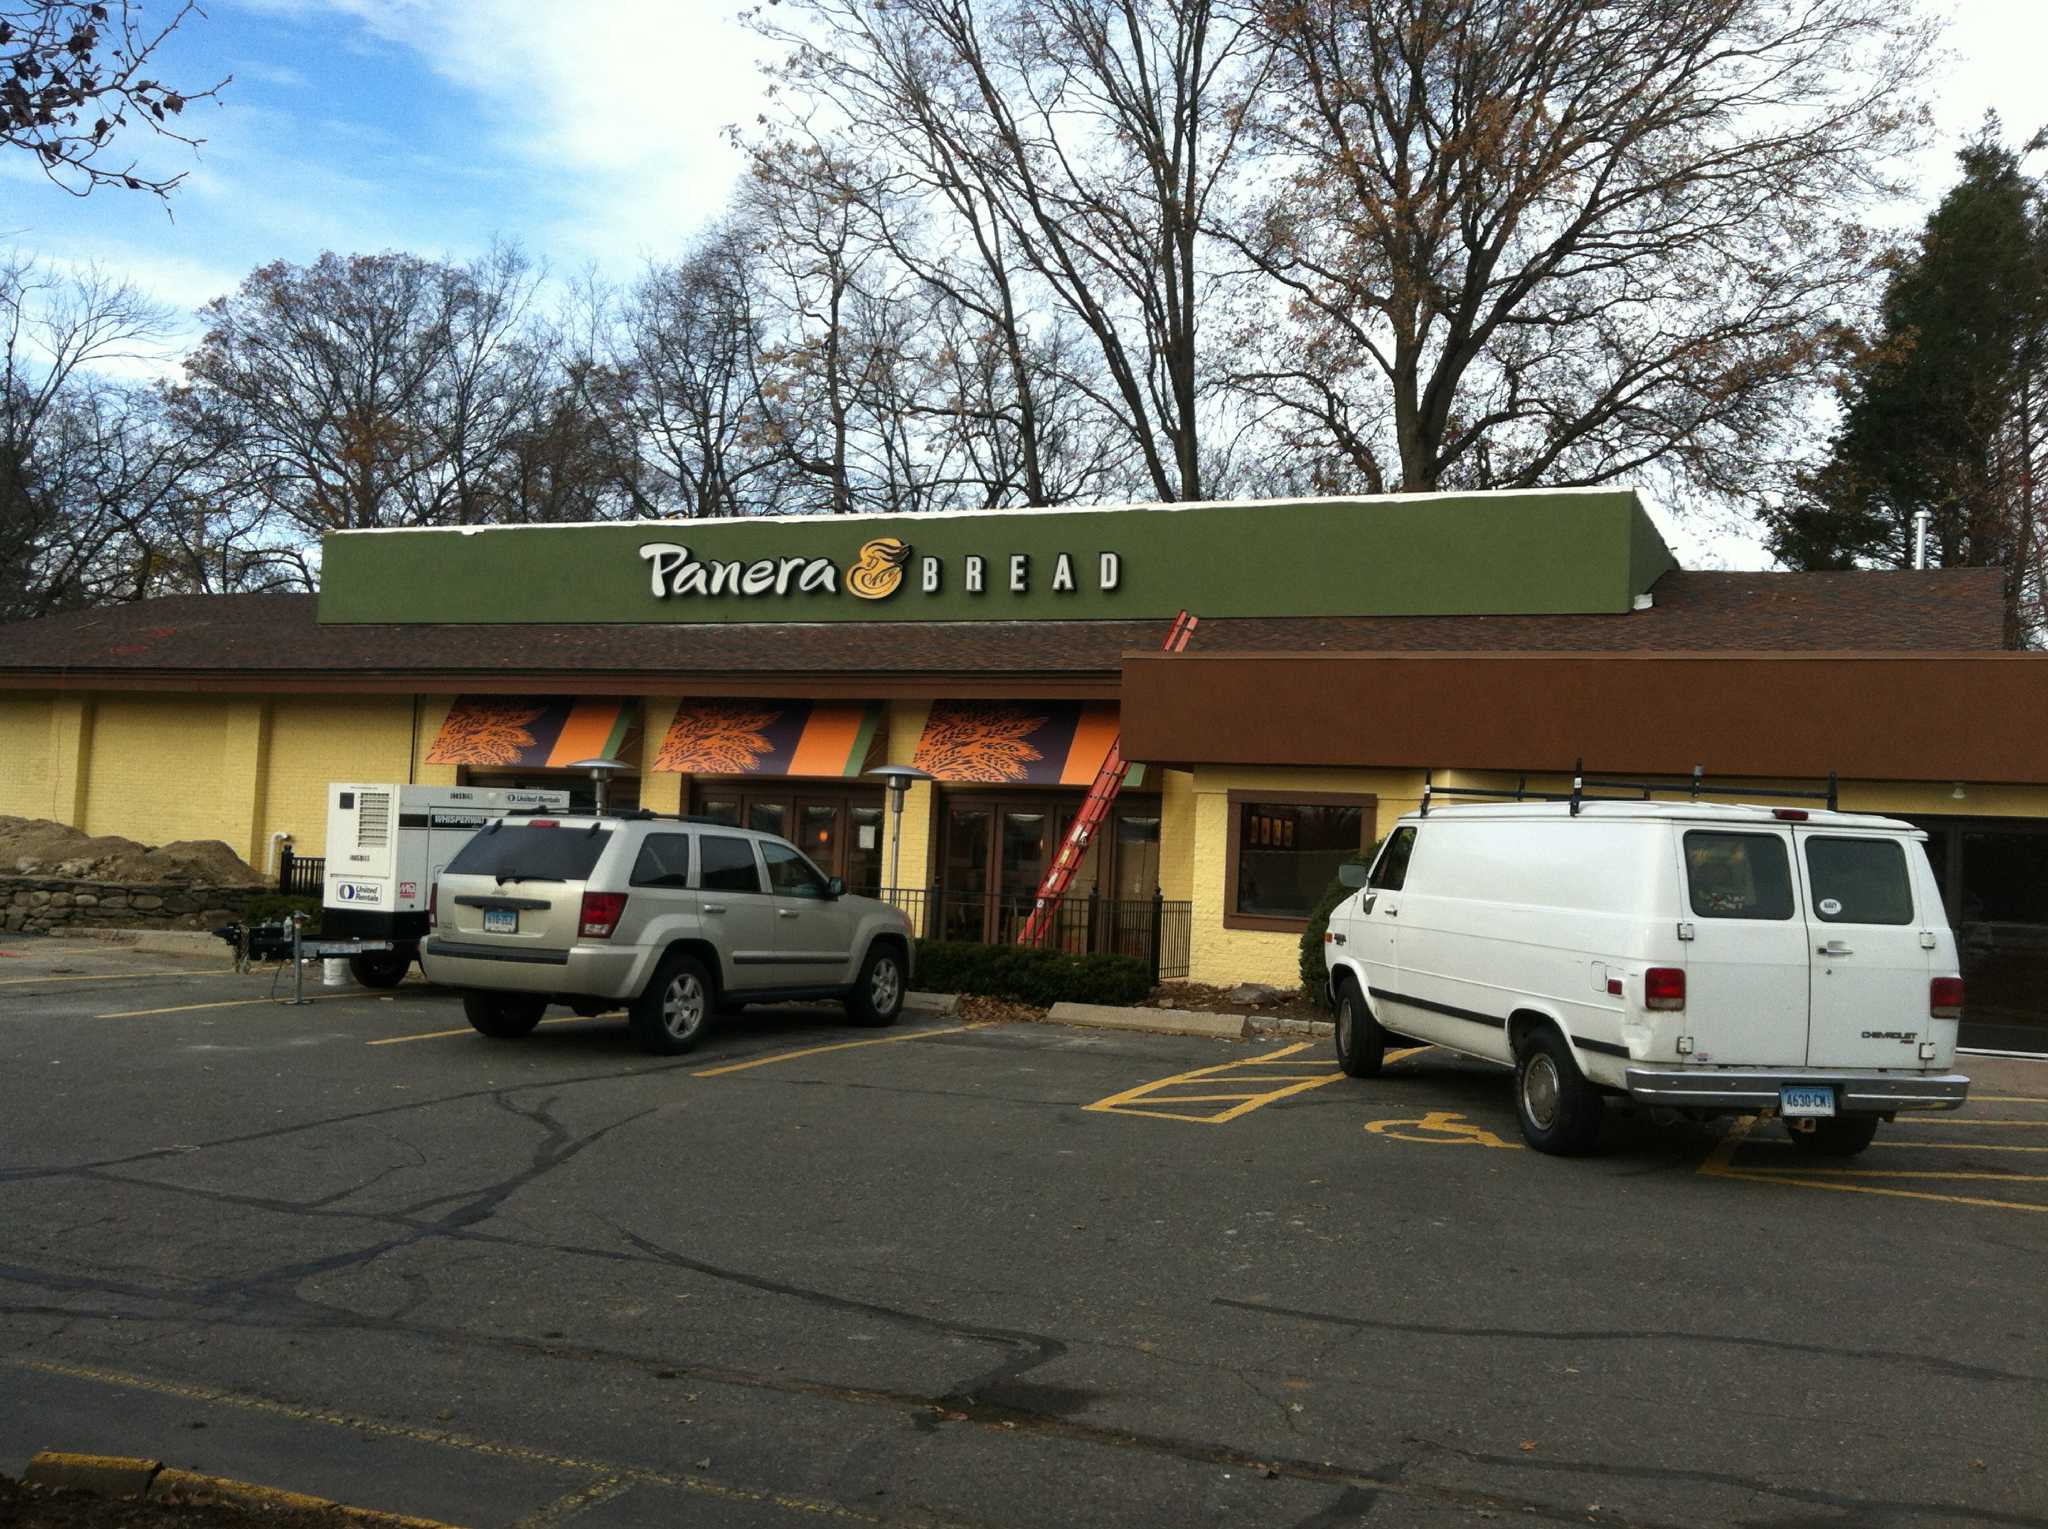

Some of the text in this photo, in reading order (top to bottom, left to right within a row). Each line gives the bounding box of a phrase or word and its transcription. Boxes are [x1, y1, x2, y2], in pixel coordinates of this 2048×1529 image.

[638, 541, 1121, 597] Panera BREAD
[355, 885, 379, 894] United
[1861, 1031, 1918, 1039] CHEVROLET
